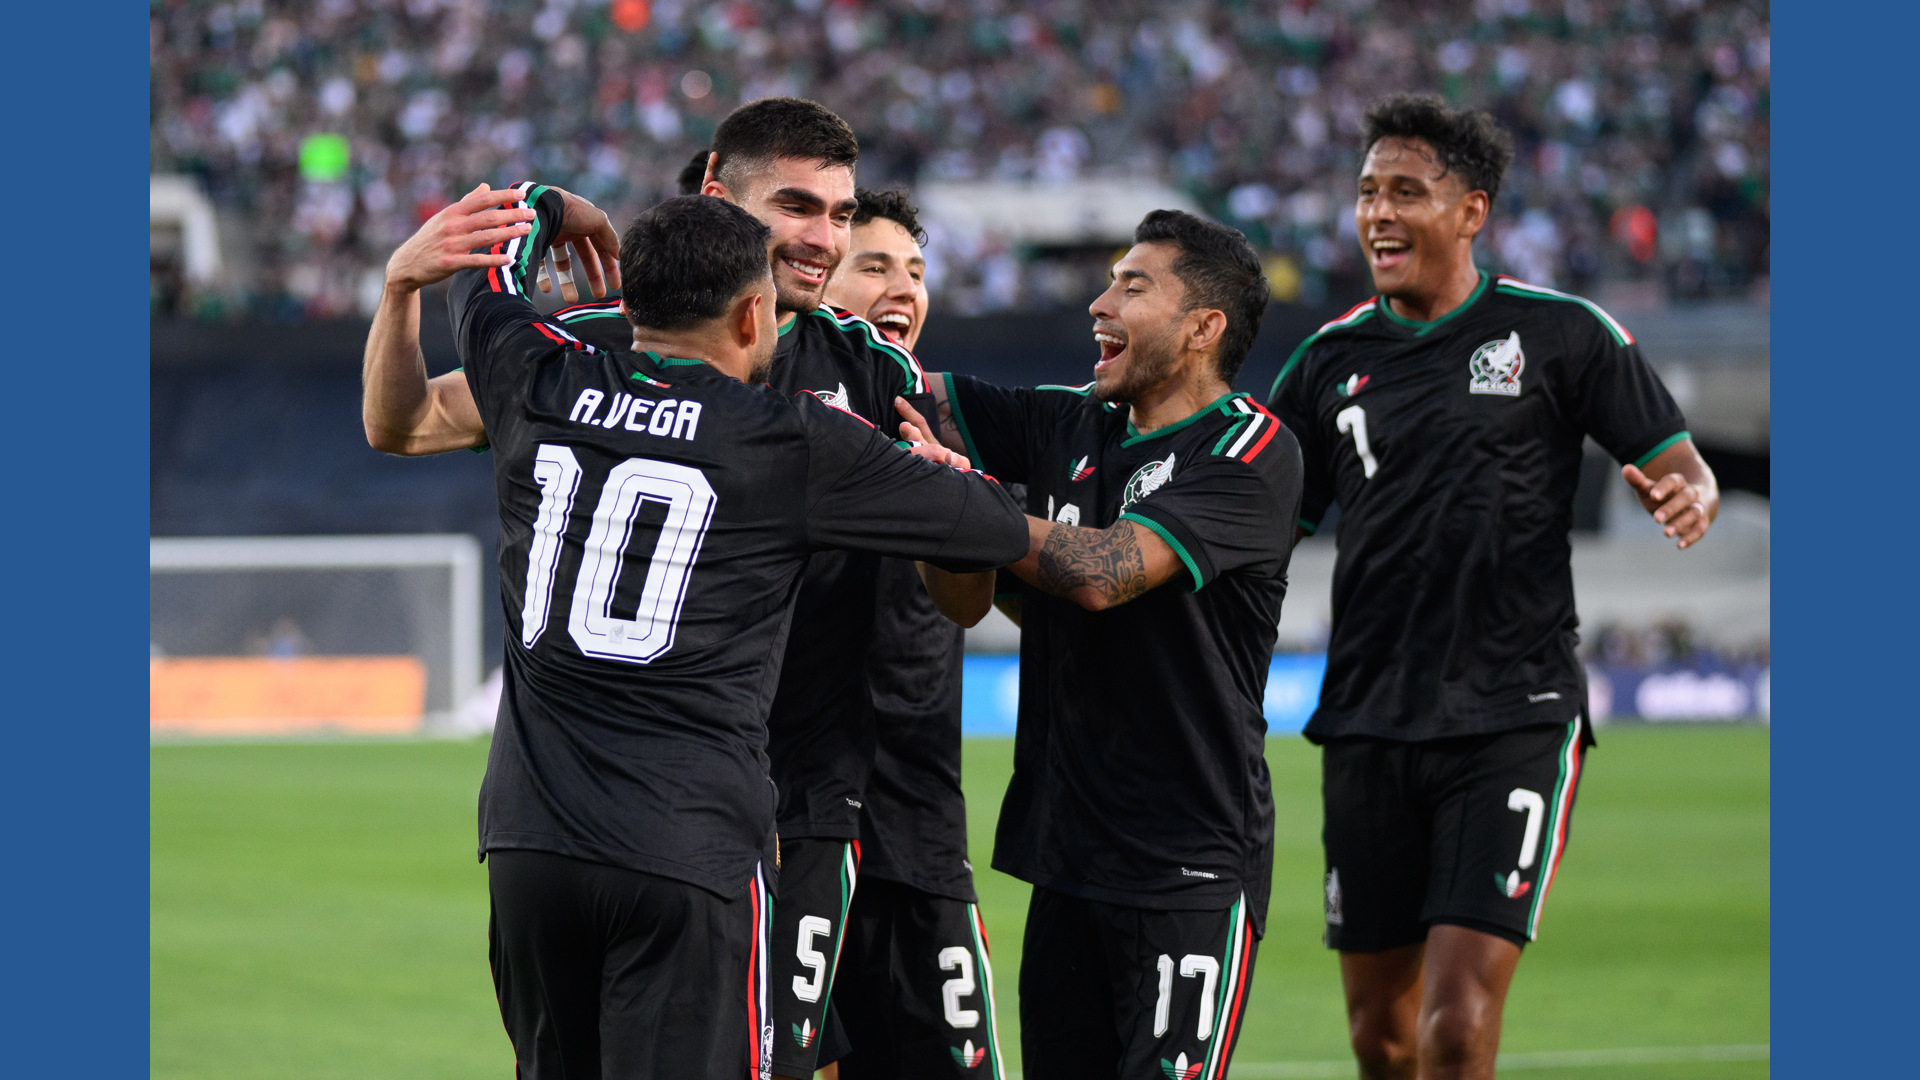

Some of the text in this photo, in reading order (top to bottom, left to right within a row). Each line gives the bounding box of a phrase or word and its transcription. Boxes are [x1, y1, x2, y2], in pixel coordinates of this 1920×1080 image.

[569, 388, 702, 441] A.VEGA
[1336, 405, 1378, 479] 7
[522, 444, 718, 664] 10
[1508, 788, 1545, 869] 7
[792, 915, 831, 1003] 5
[938, 946, 979, 1028] 2
[1154, 954, 1220, 1041] 17
